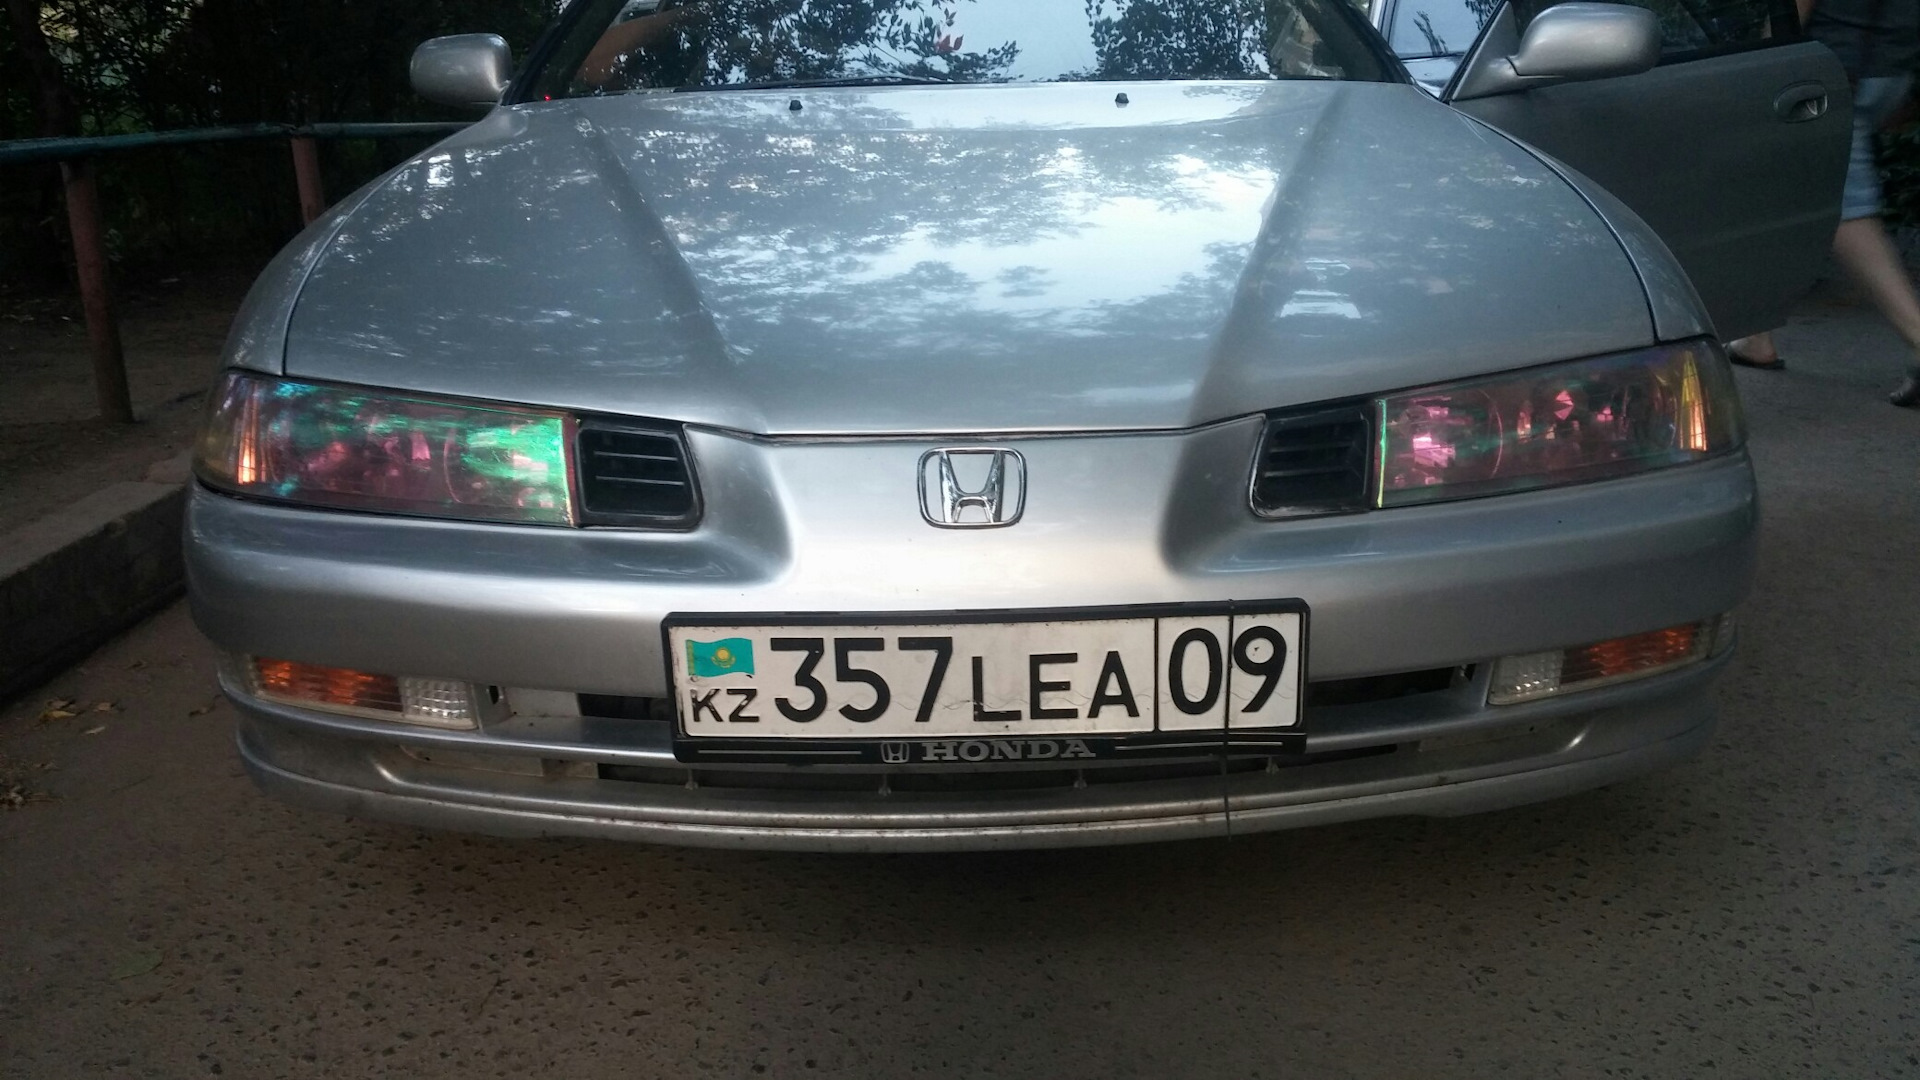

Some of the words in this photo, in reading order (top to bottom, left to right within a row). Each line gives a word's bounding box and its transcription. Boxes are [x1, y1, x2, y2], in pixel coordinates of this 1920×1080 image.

[770, 637, 953, 723] 357
[971, 651, 1140, 722] LEA
[1168, 626, 1288, 715] 09
[691, 687, 760, 723] KZ
[921, 739, 1096, 762] HONDA
